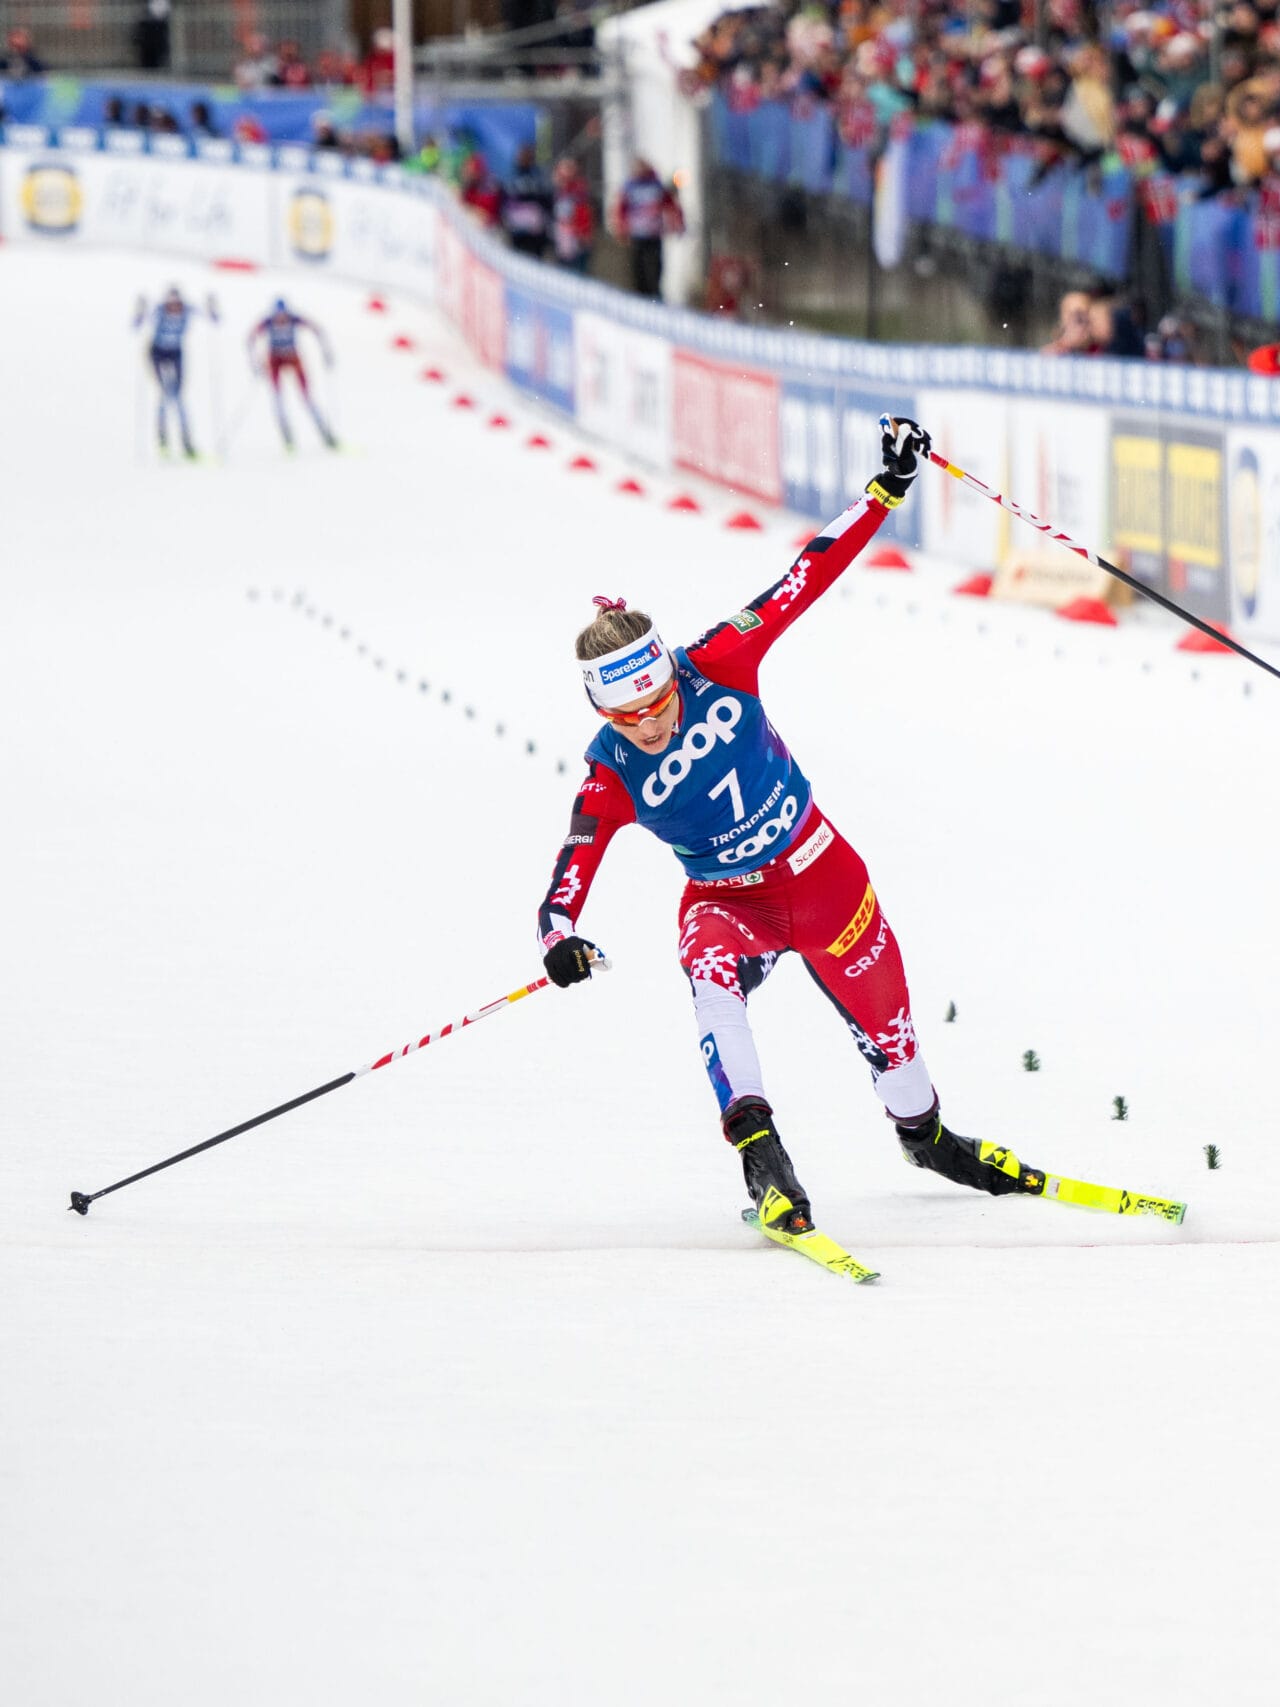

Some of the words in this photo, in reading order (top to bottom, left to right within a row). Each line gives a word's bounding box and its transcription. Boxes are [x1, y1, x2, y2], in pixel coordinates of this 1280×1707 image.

[602, 652, 652, 682] SpareBank
[642, 696, 742, 807] coop
[708, 768, 745, 823] 7
[709, 780, 785, 846] TRONDHEIM
[717, 795, 798, 864] coop
[795, 830, 830, 866] Scandic
[838, 898, 873, 949] DHL
[844, 918, 888, 977] CRAFT
